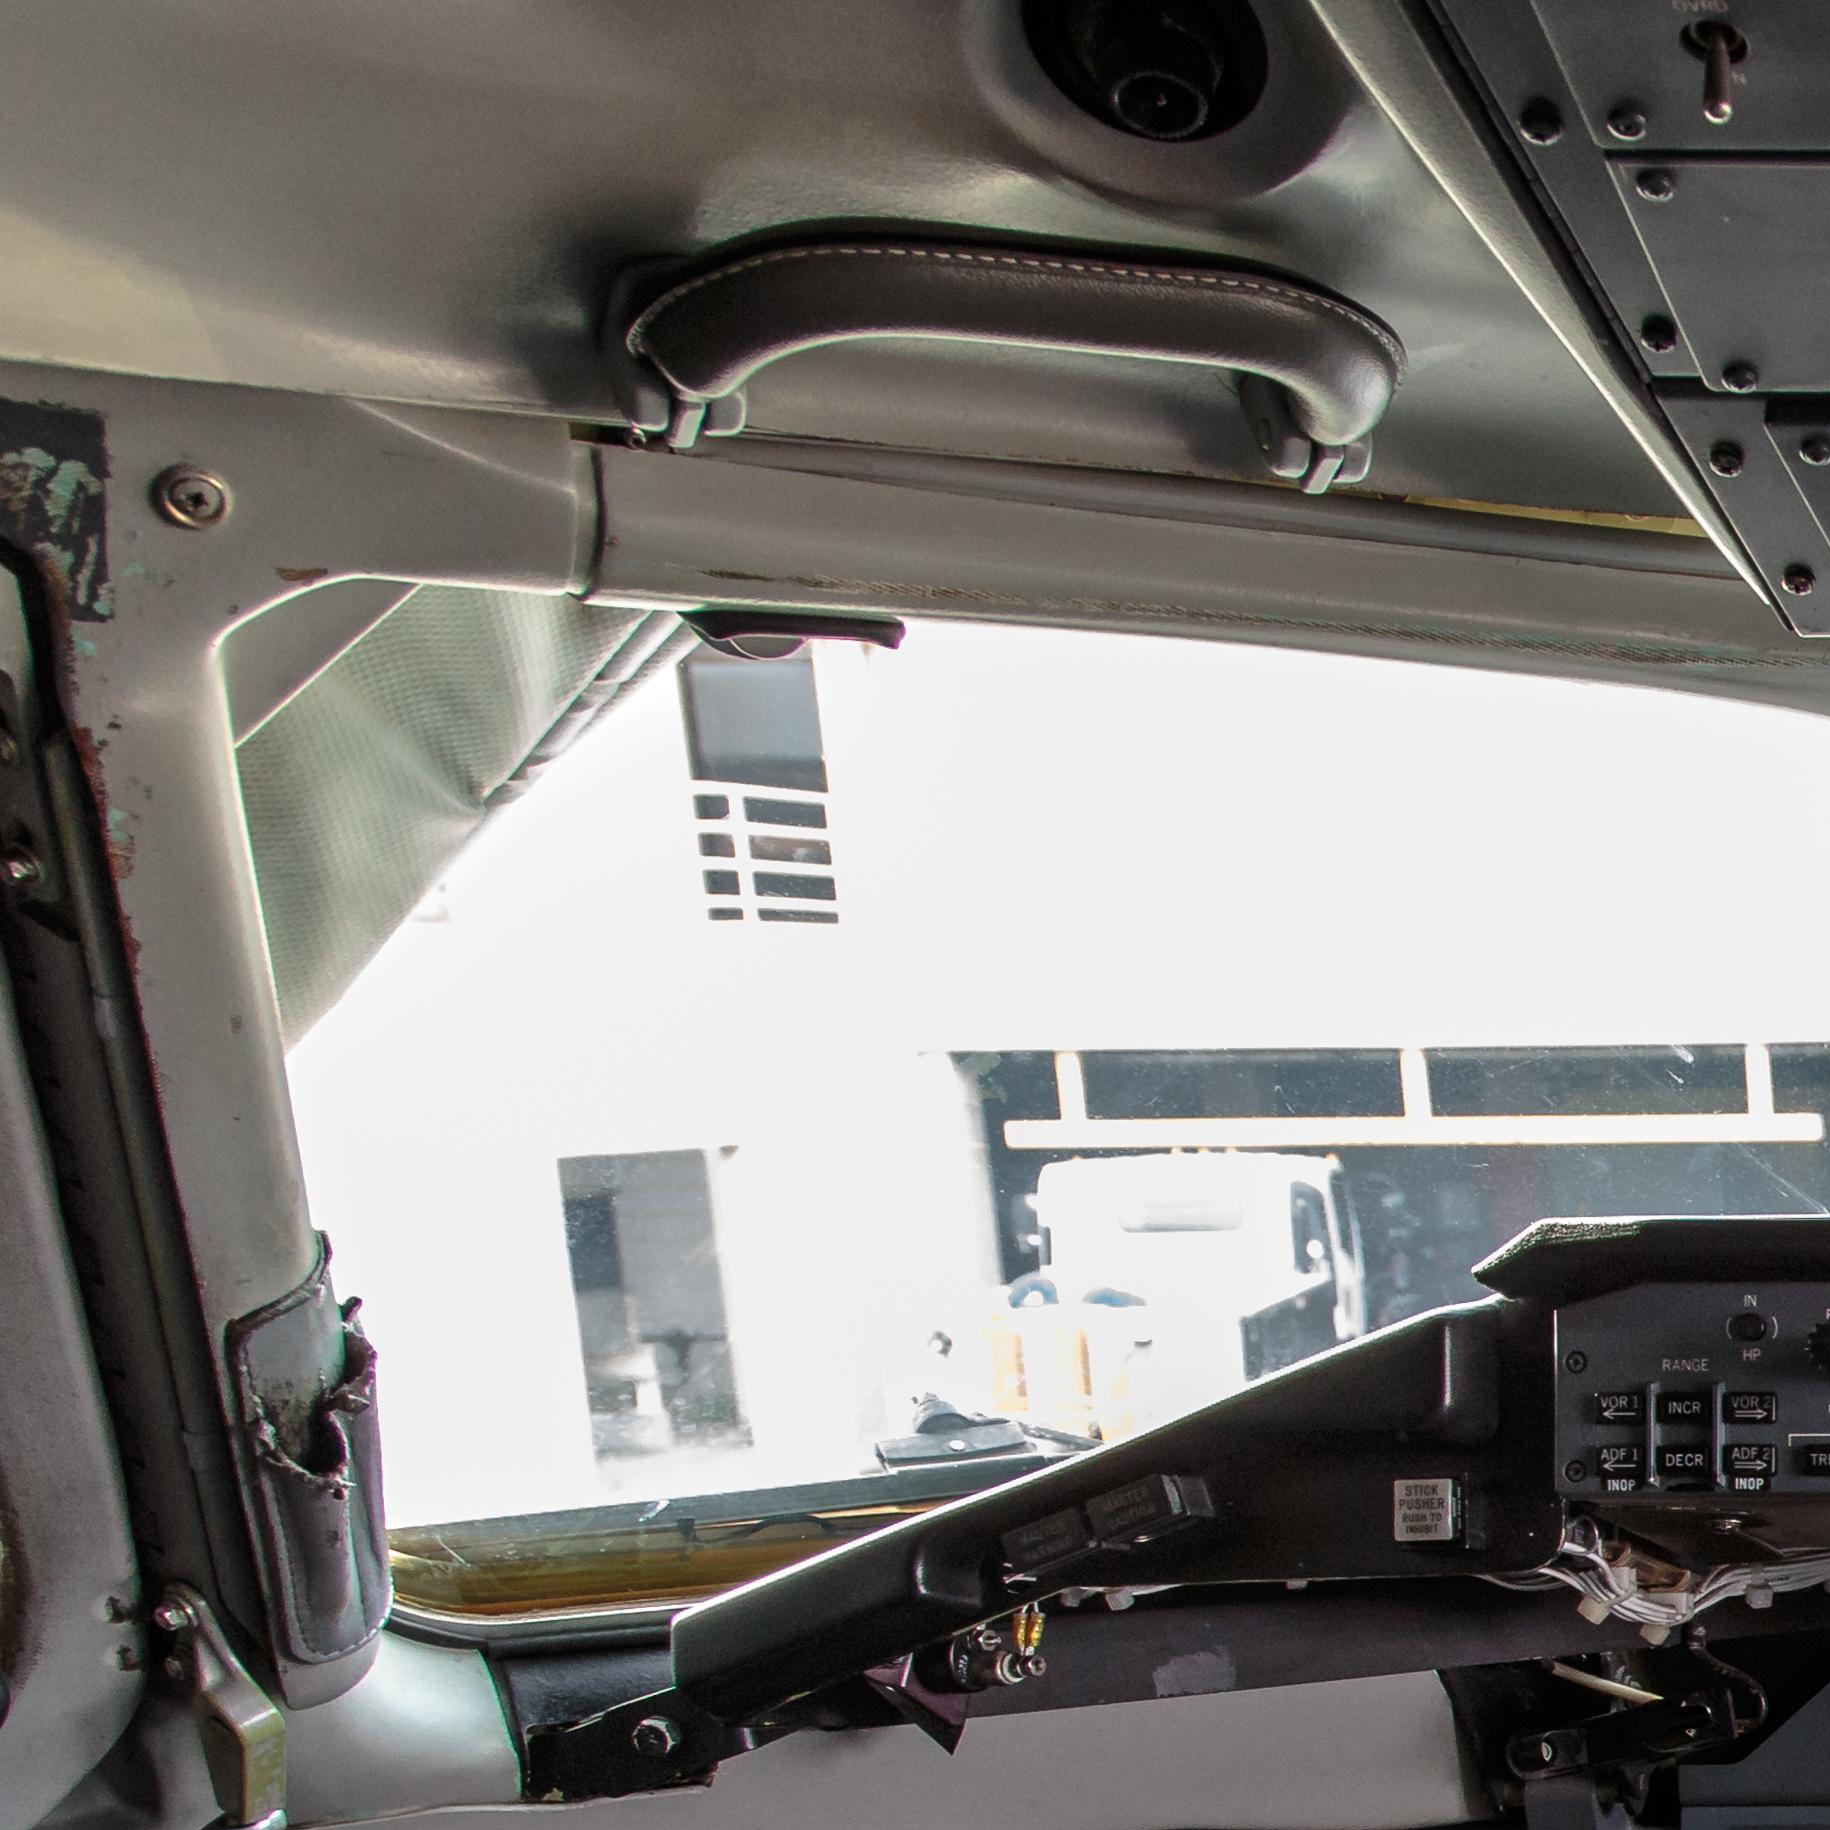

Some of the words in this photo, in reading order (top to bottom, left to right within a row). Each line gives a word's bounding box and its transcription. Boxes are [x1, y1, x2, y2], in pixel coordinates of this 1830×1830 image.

[1404, 1484, 1439, 1496] STICK
[1607, 1478, 1637, 1491] INOP
[1398, 1497, 1445, 1510] PUSHER
